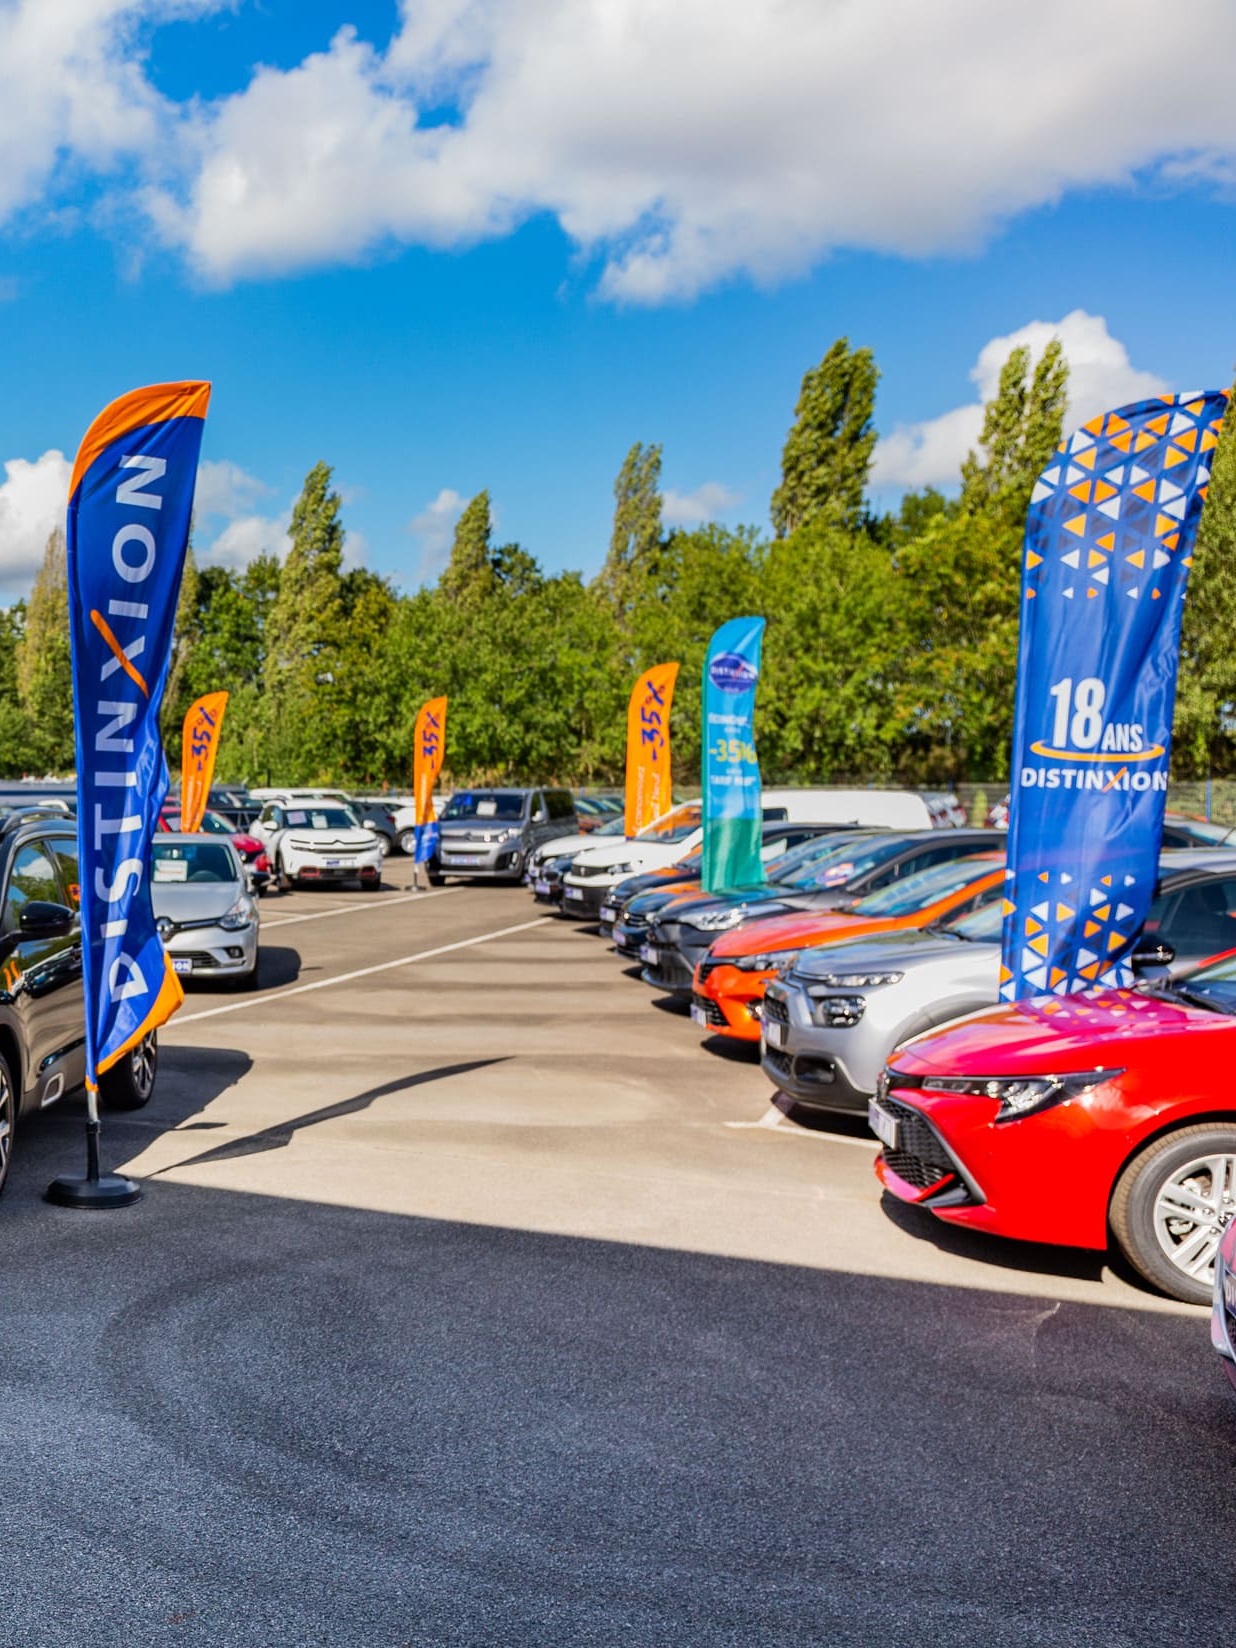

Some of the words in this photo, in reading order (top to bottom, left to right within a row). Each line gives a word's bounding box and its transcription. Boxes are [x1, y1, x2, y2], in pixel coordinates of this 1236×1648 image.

[90, 455, 167, 1003] DISTINXION
[192, 706, 217, 772] -35%
[422, 711, 440, 769] -35%
[640, 678, 666, 761] -35%
[1050, 678, 1106, 749] 18
[1101, 723, 1144, 752] ANS
[1021, 766, 1168, 792] DISTINXION
